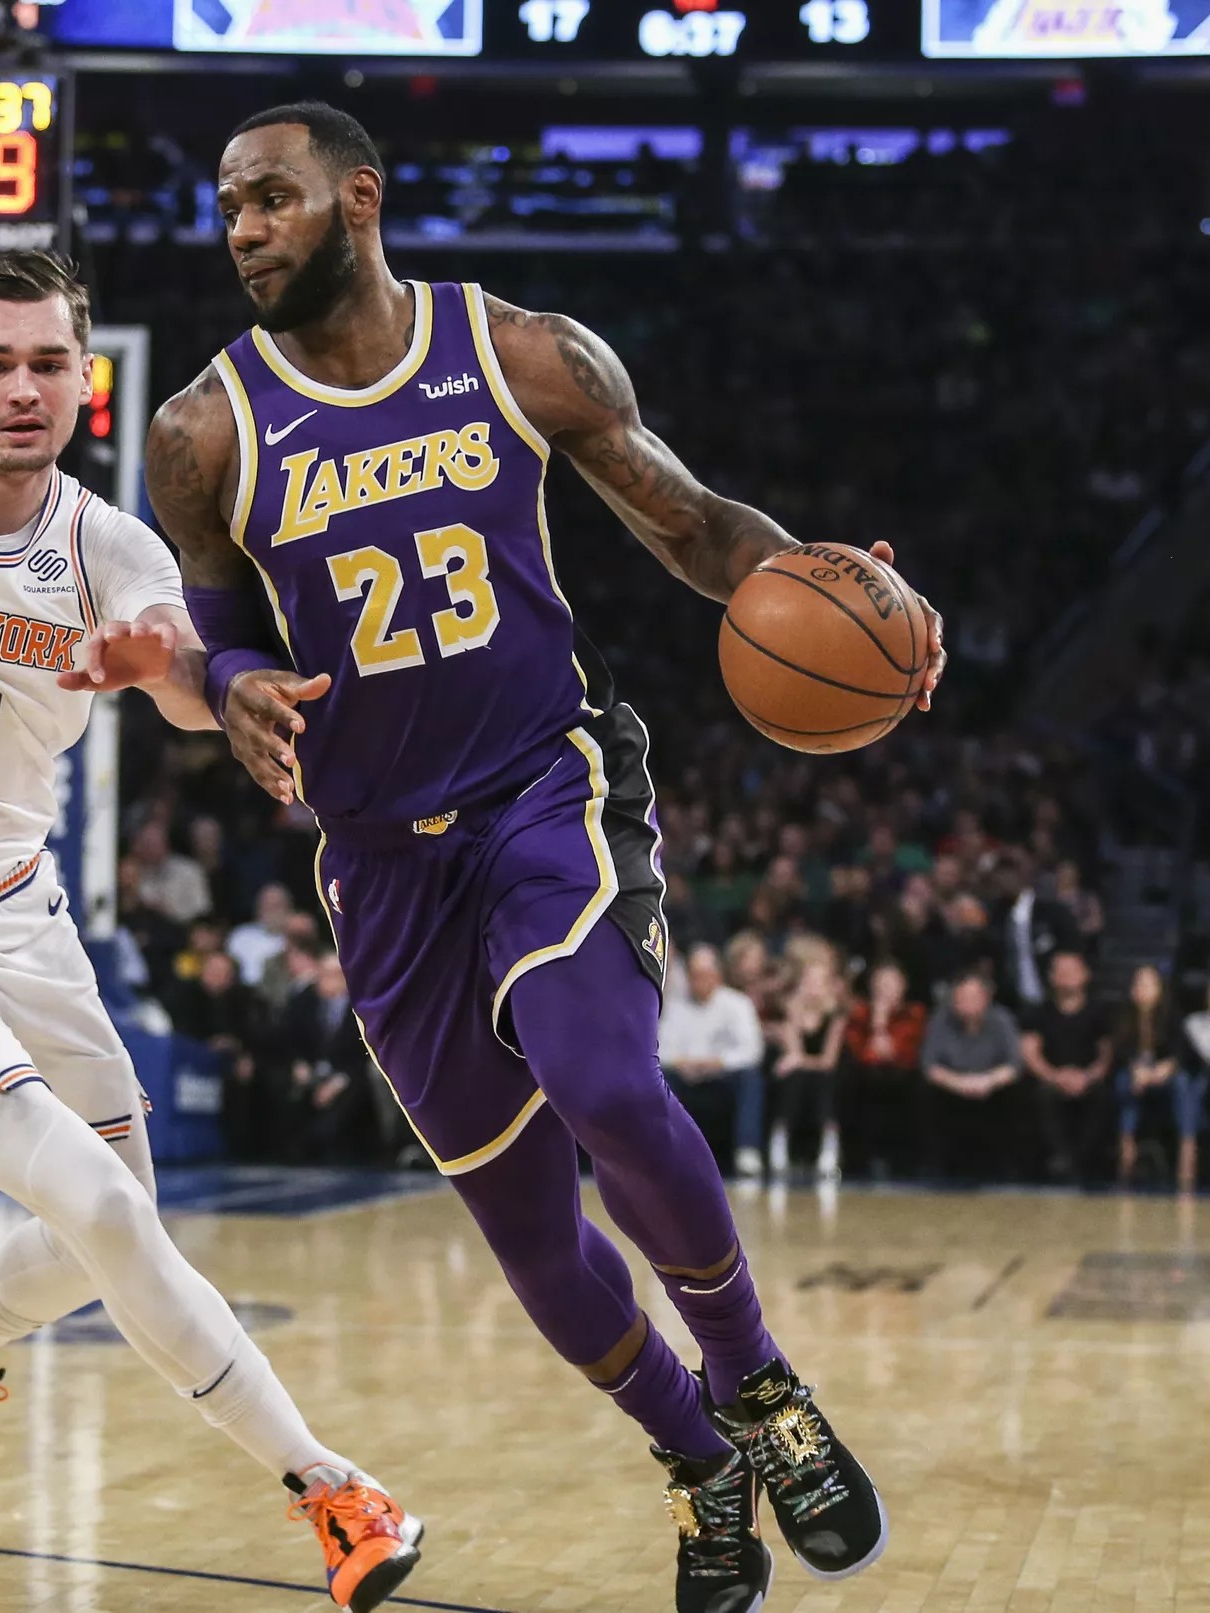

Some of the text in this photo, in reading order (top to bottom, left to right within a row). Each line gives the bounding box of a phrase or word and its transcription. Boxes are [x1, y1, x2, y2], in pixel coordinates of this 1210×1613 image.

[518, 0, 589, 42] 17
[799, 0, 870, 43] 13
[418, 373, 479, 400] wish
[271, 421, 500, 548] LAKERS
[23, 585, 76, 594] SQUARESPACE
[325, 522, 501, 678] 23
